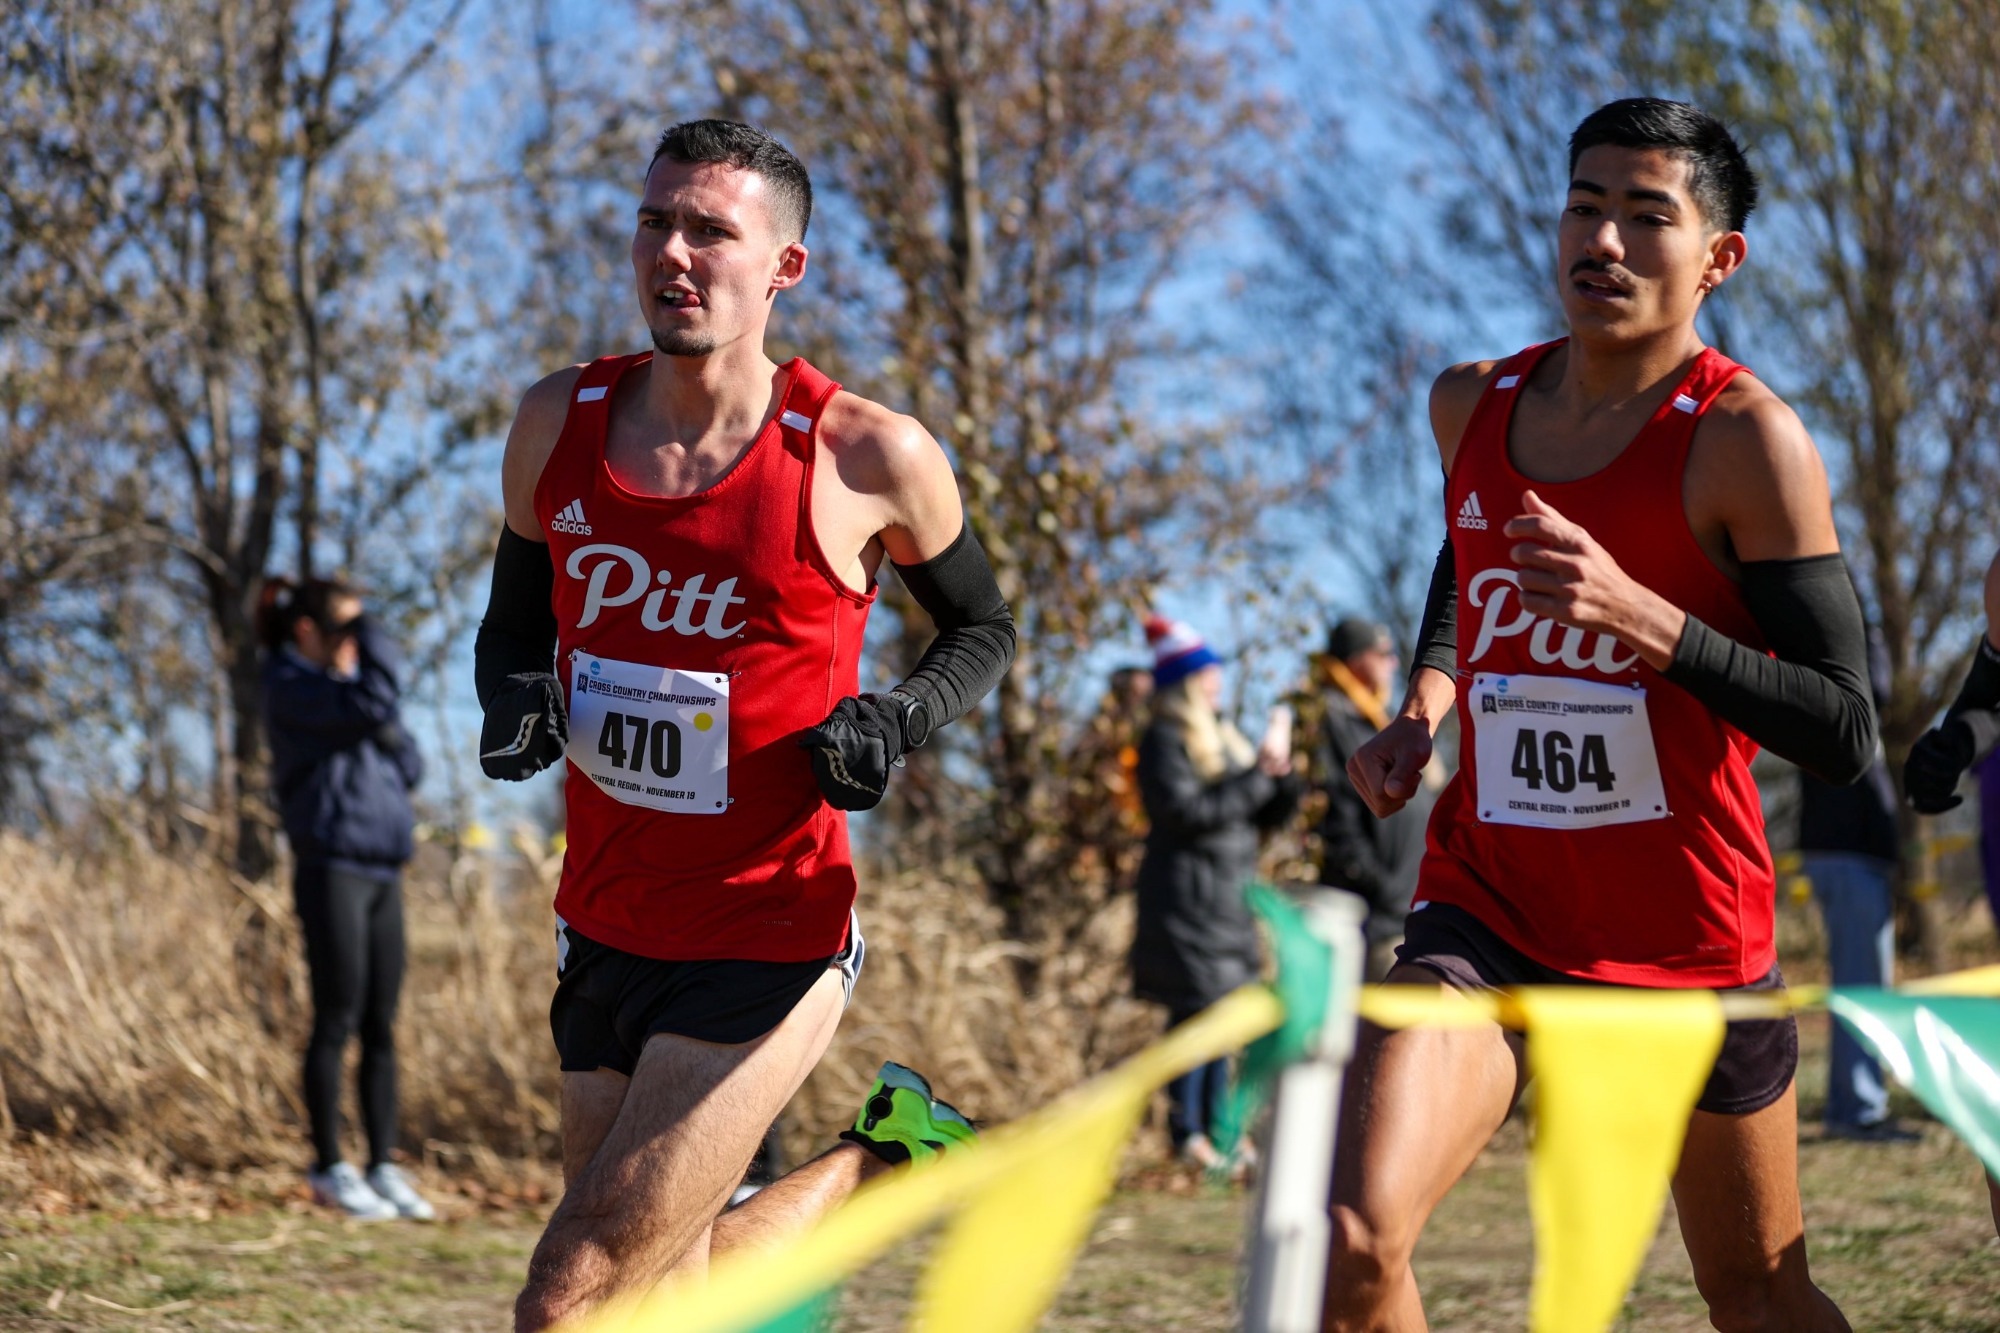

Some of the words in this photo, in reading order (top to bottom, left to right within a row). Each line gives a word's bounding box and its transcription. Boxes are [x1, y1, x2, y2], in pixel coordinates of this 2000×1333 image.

[552, 519, 592, 536] adidas
[1457, 516, 1488, 530] adidas
[566, 543, 746, 639] Pitt
[589, 680, 611, 693] CROSS
[613, 685, 647, 699] COUNTRY
[648, 691, 716, 707] CHAMPIONSHIPS
[1498, 698, 1524, 709] CROSS
[1526, 700, 1560, 711] COUNTRY
[1562, 702, 1633, 715] CHAMPIONSHIPS
[598, 711, 681, 778] 470
[1511, 728, 1616, 793] 464
[591, 773, 616, 787] CENTRAL
[617, 780, 641, 792] REGION
[646, 786, 685, 800] NOVEMBER
[686, 790, 696, 800] 19
[1509, 800, 1539, 812] CENTRAL
[1540, 804, 1567, 814] REGION
[1573, 801, 1619, 814] NOVEMBER
